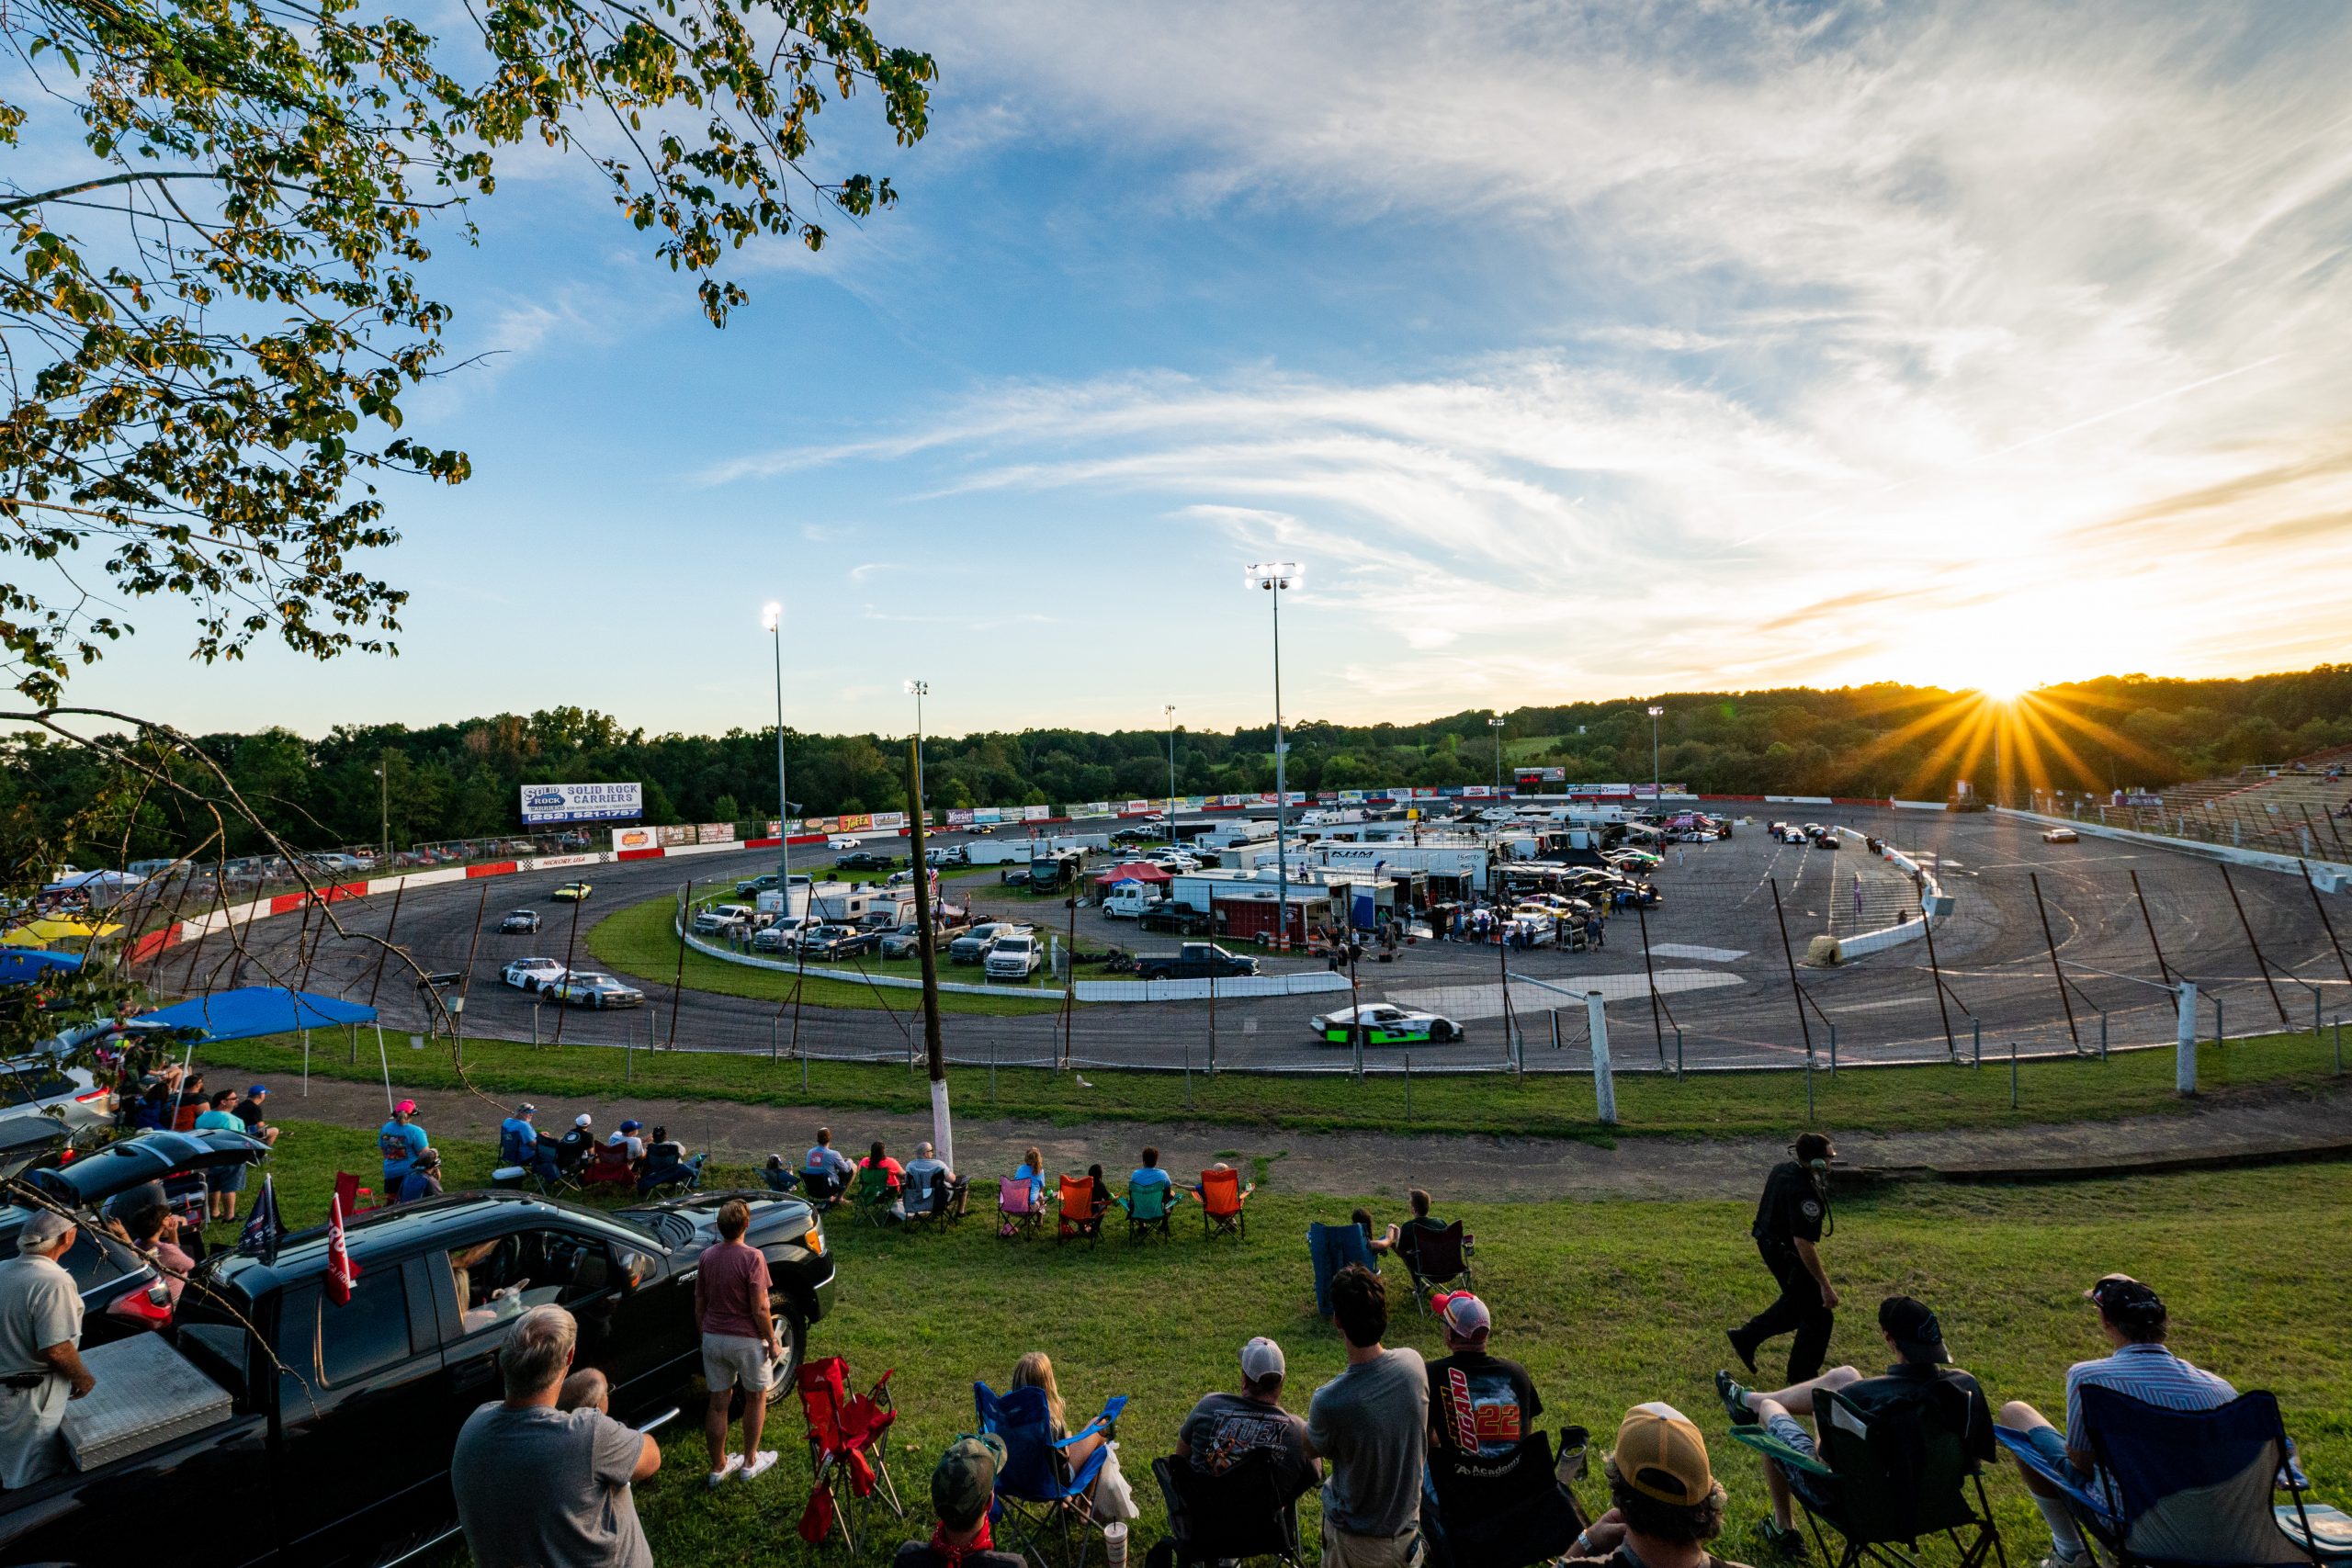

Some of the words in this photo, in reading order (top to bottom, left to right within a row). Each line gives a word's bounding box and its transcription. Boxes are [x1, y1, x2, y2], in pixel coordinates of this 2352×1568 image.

[524, 787, 560, 801] SOLID
[567, 785, 602, 795] SOLID
[607, 784, 639, 794] ROCK
[573, 794, 633, 804] CARRIERS
[527, 812, 568, 821] (252)
[572, 808, 639, 818] 521-1757
[948, 811, 973, 823] Hoosier
[843, 814, 869, 832] Jeff's
[1448, 1367, 1480, 1455] OGANO
[1209, 1410, 1288, 1445] TRUEX
[1476, 1404, 1521, 1436] 22
[1472, 1455, 1521, 1475] Academy
